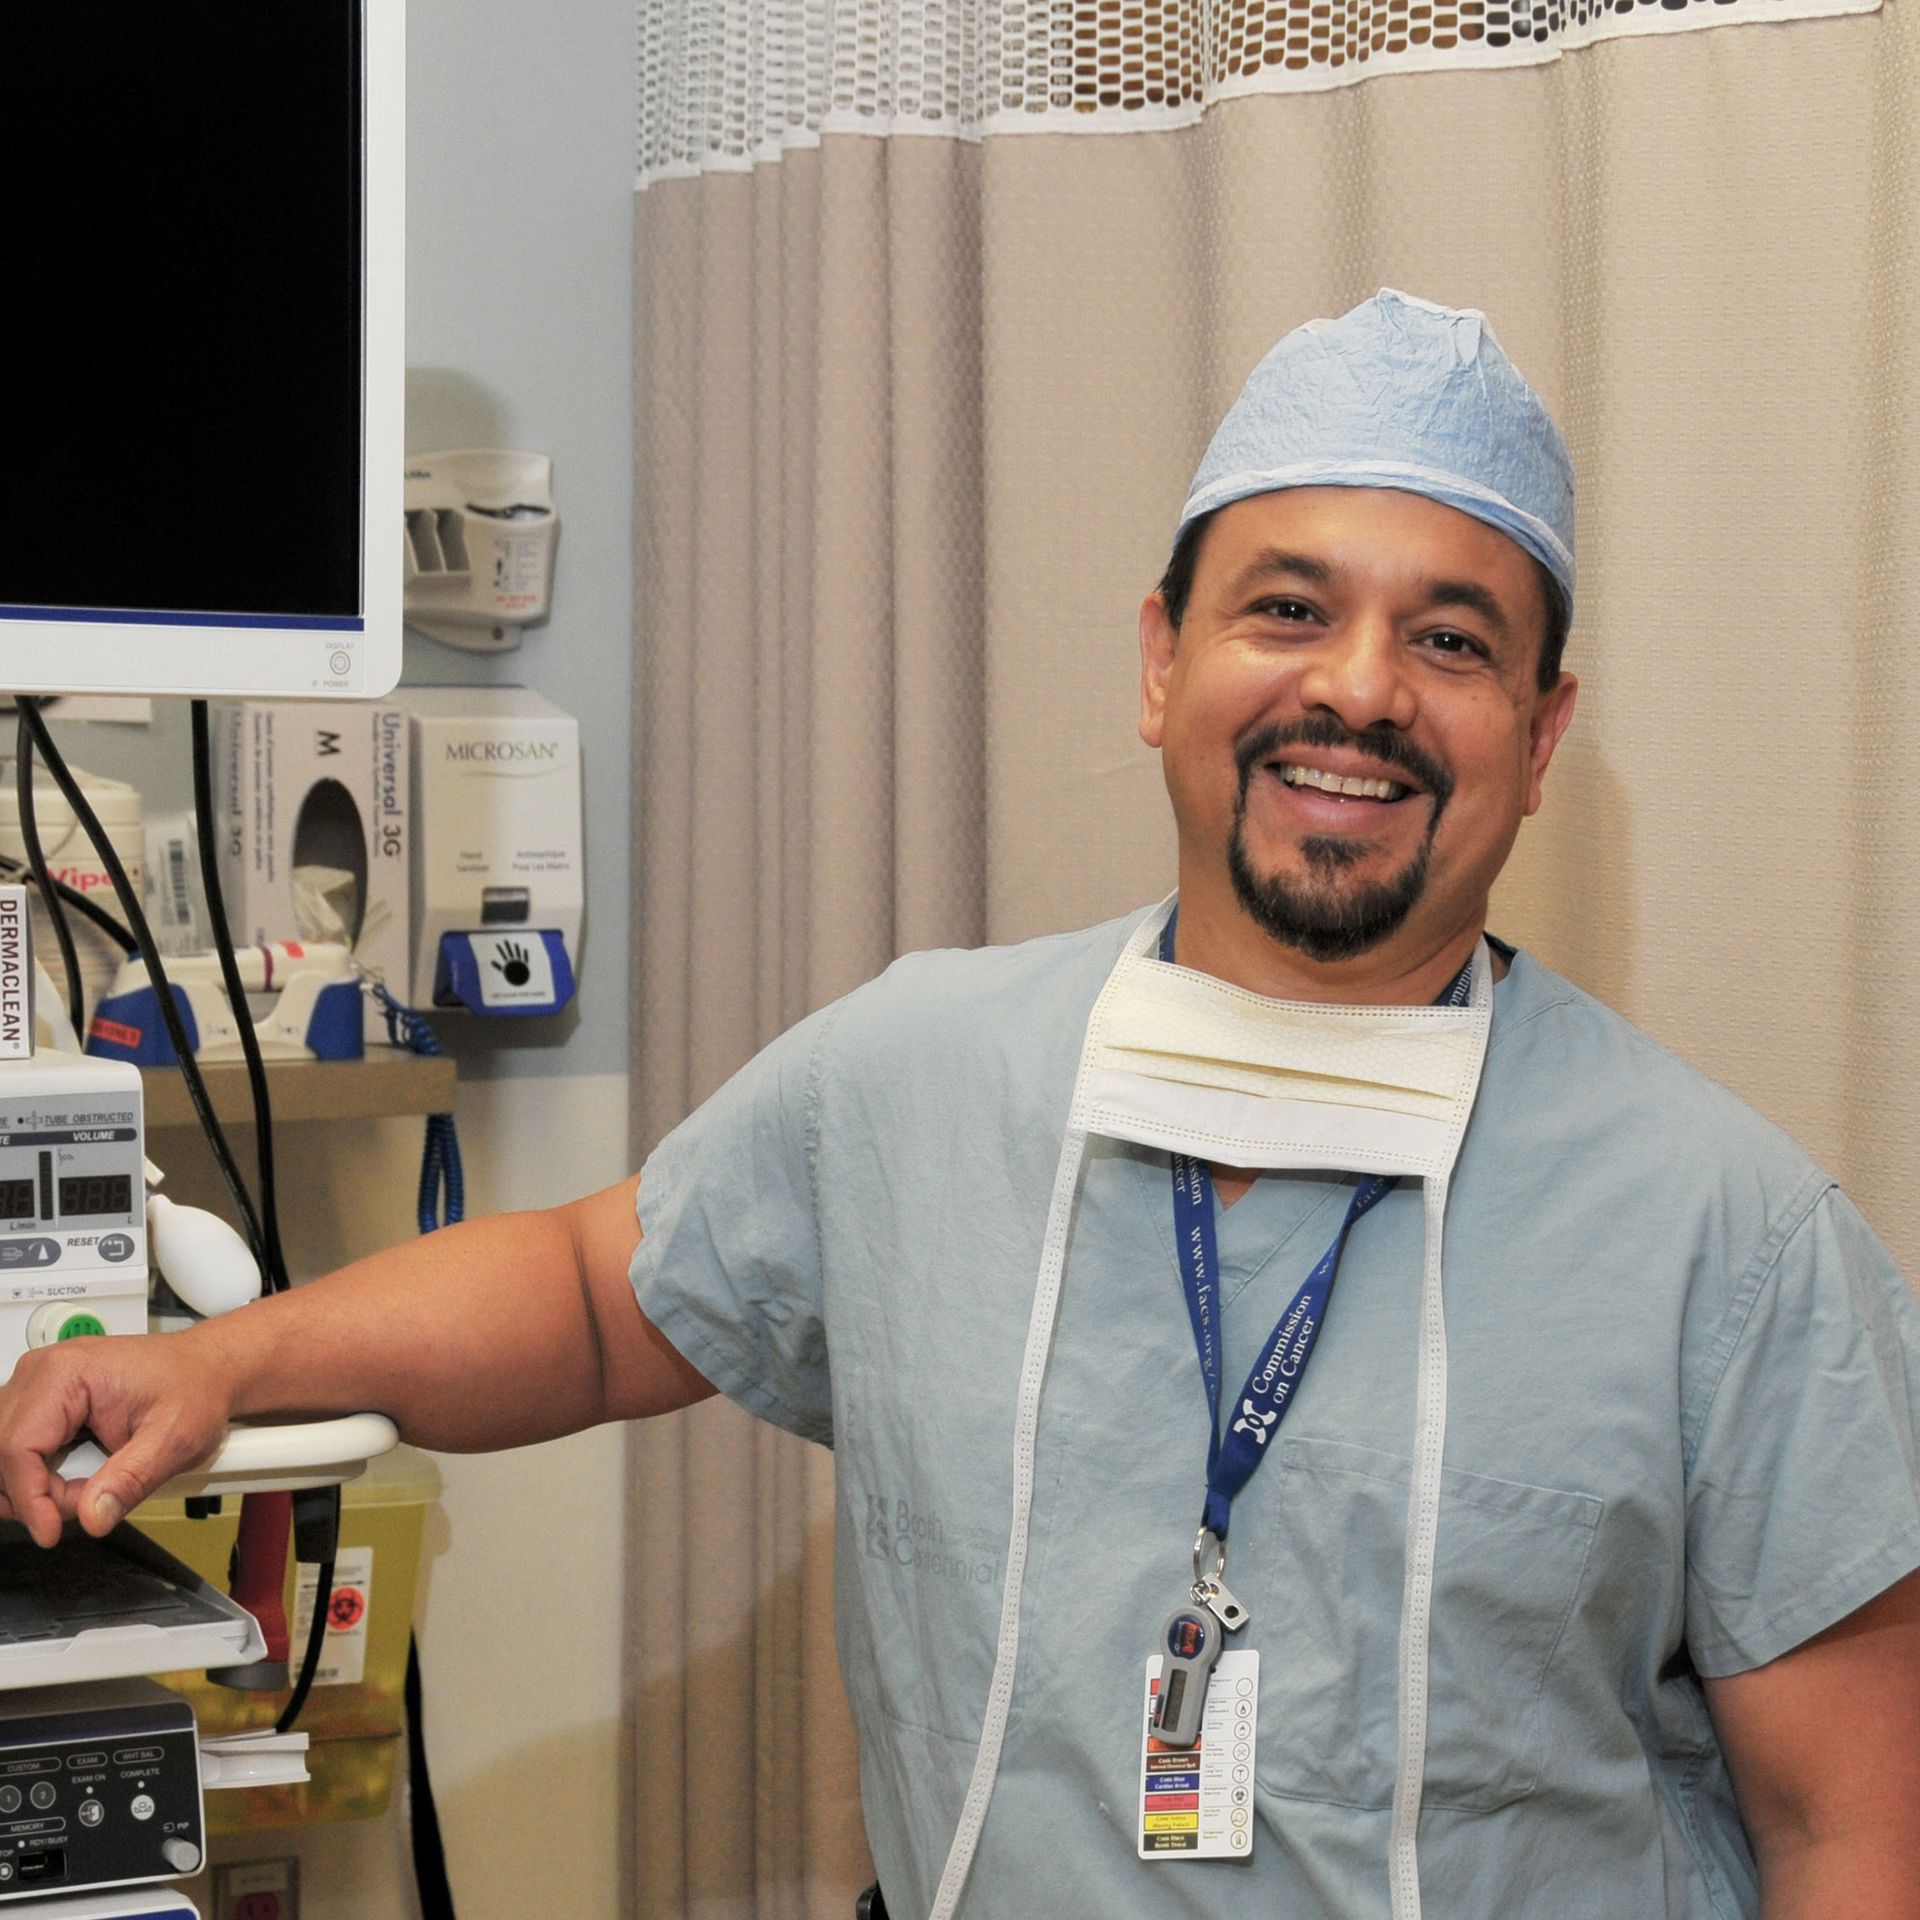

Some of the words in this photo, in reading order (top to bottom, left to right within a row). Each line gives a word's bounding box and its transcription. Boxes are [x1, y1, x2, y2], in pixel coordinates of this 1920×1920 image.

[316, 730, 341, 756] M
[382, 712, 403, 816] Universal
[382, 823, 403, 857] 3G
[45, 1113, 69, 1125] TUBE
[72, 1112, 134, 1123] OBSTRUCTED
[73, 1130, 116, 1141] VOLUME
[67, 1236, 100, 1248] RESET
[47, 1286, 87, 1297] SUCTION
[1252, 1295, 1312, 1394] Commission
[1280, 1315, 1315, 1377] Cancer
[1273, 1381, 1290, 1404] on
[7, 1762, 41, 1772] CUSTOM
[119, 1767, 160, 1779] COMPLETE
[71, 1775, 93, 1784] EXAM
[10, 1822, 46, 1832] MEMORY
